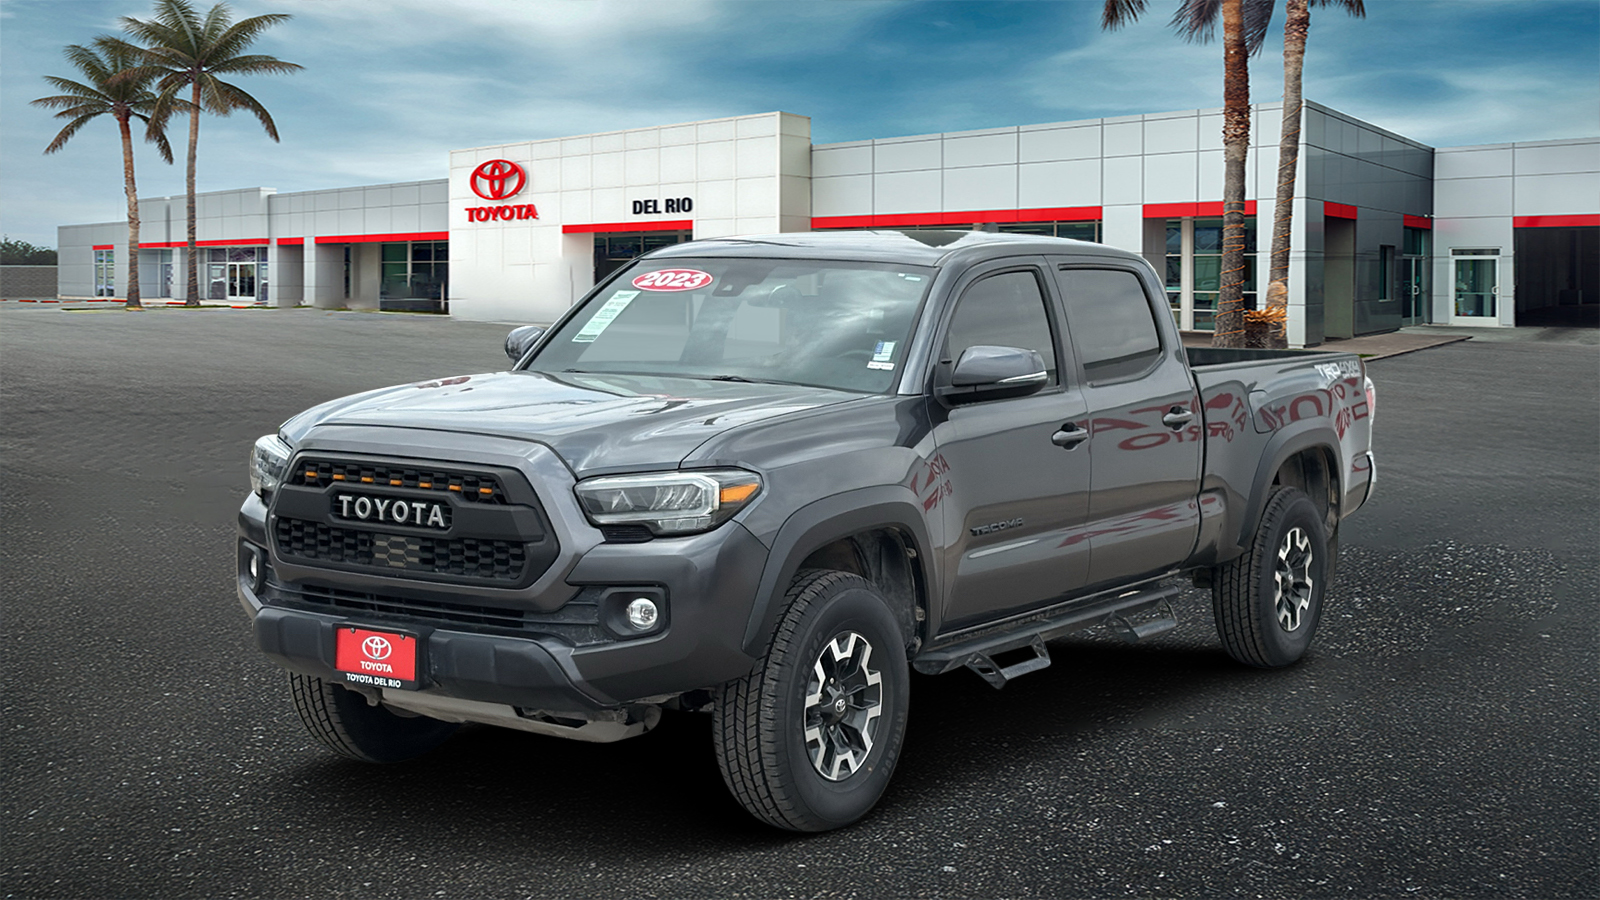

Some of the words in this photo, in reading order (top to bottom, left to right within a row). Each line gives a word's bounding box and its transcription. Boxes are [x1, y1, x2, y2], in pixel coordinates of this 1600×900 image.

[465, 204, 539, 223] TOYOTA
[632, 200, 661, 215] DEL
[665, 197, 693, 213] RIO
[637, 272, 706, 288] 2023
[338, 495, 446, 527] TOYOTA
[970, 517, 1024, 536] TACOMA
[360, 661, 393, 673] TOYOTA
[346, 673, 373, 684] TOYOTA
[374, 677, 387, 687] DEL
[388, 679, 402, 688] RIO
